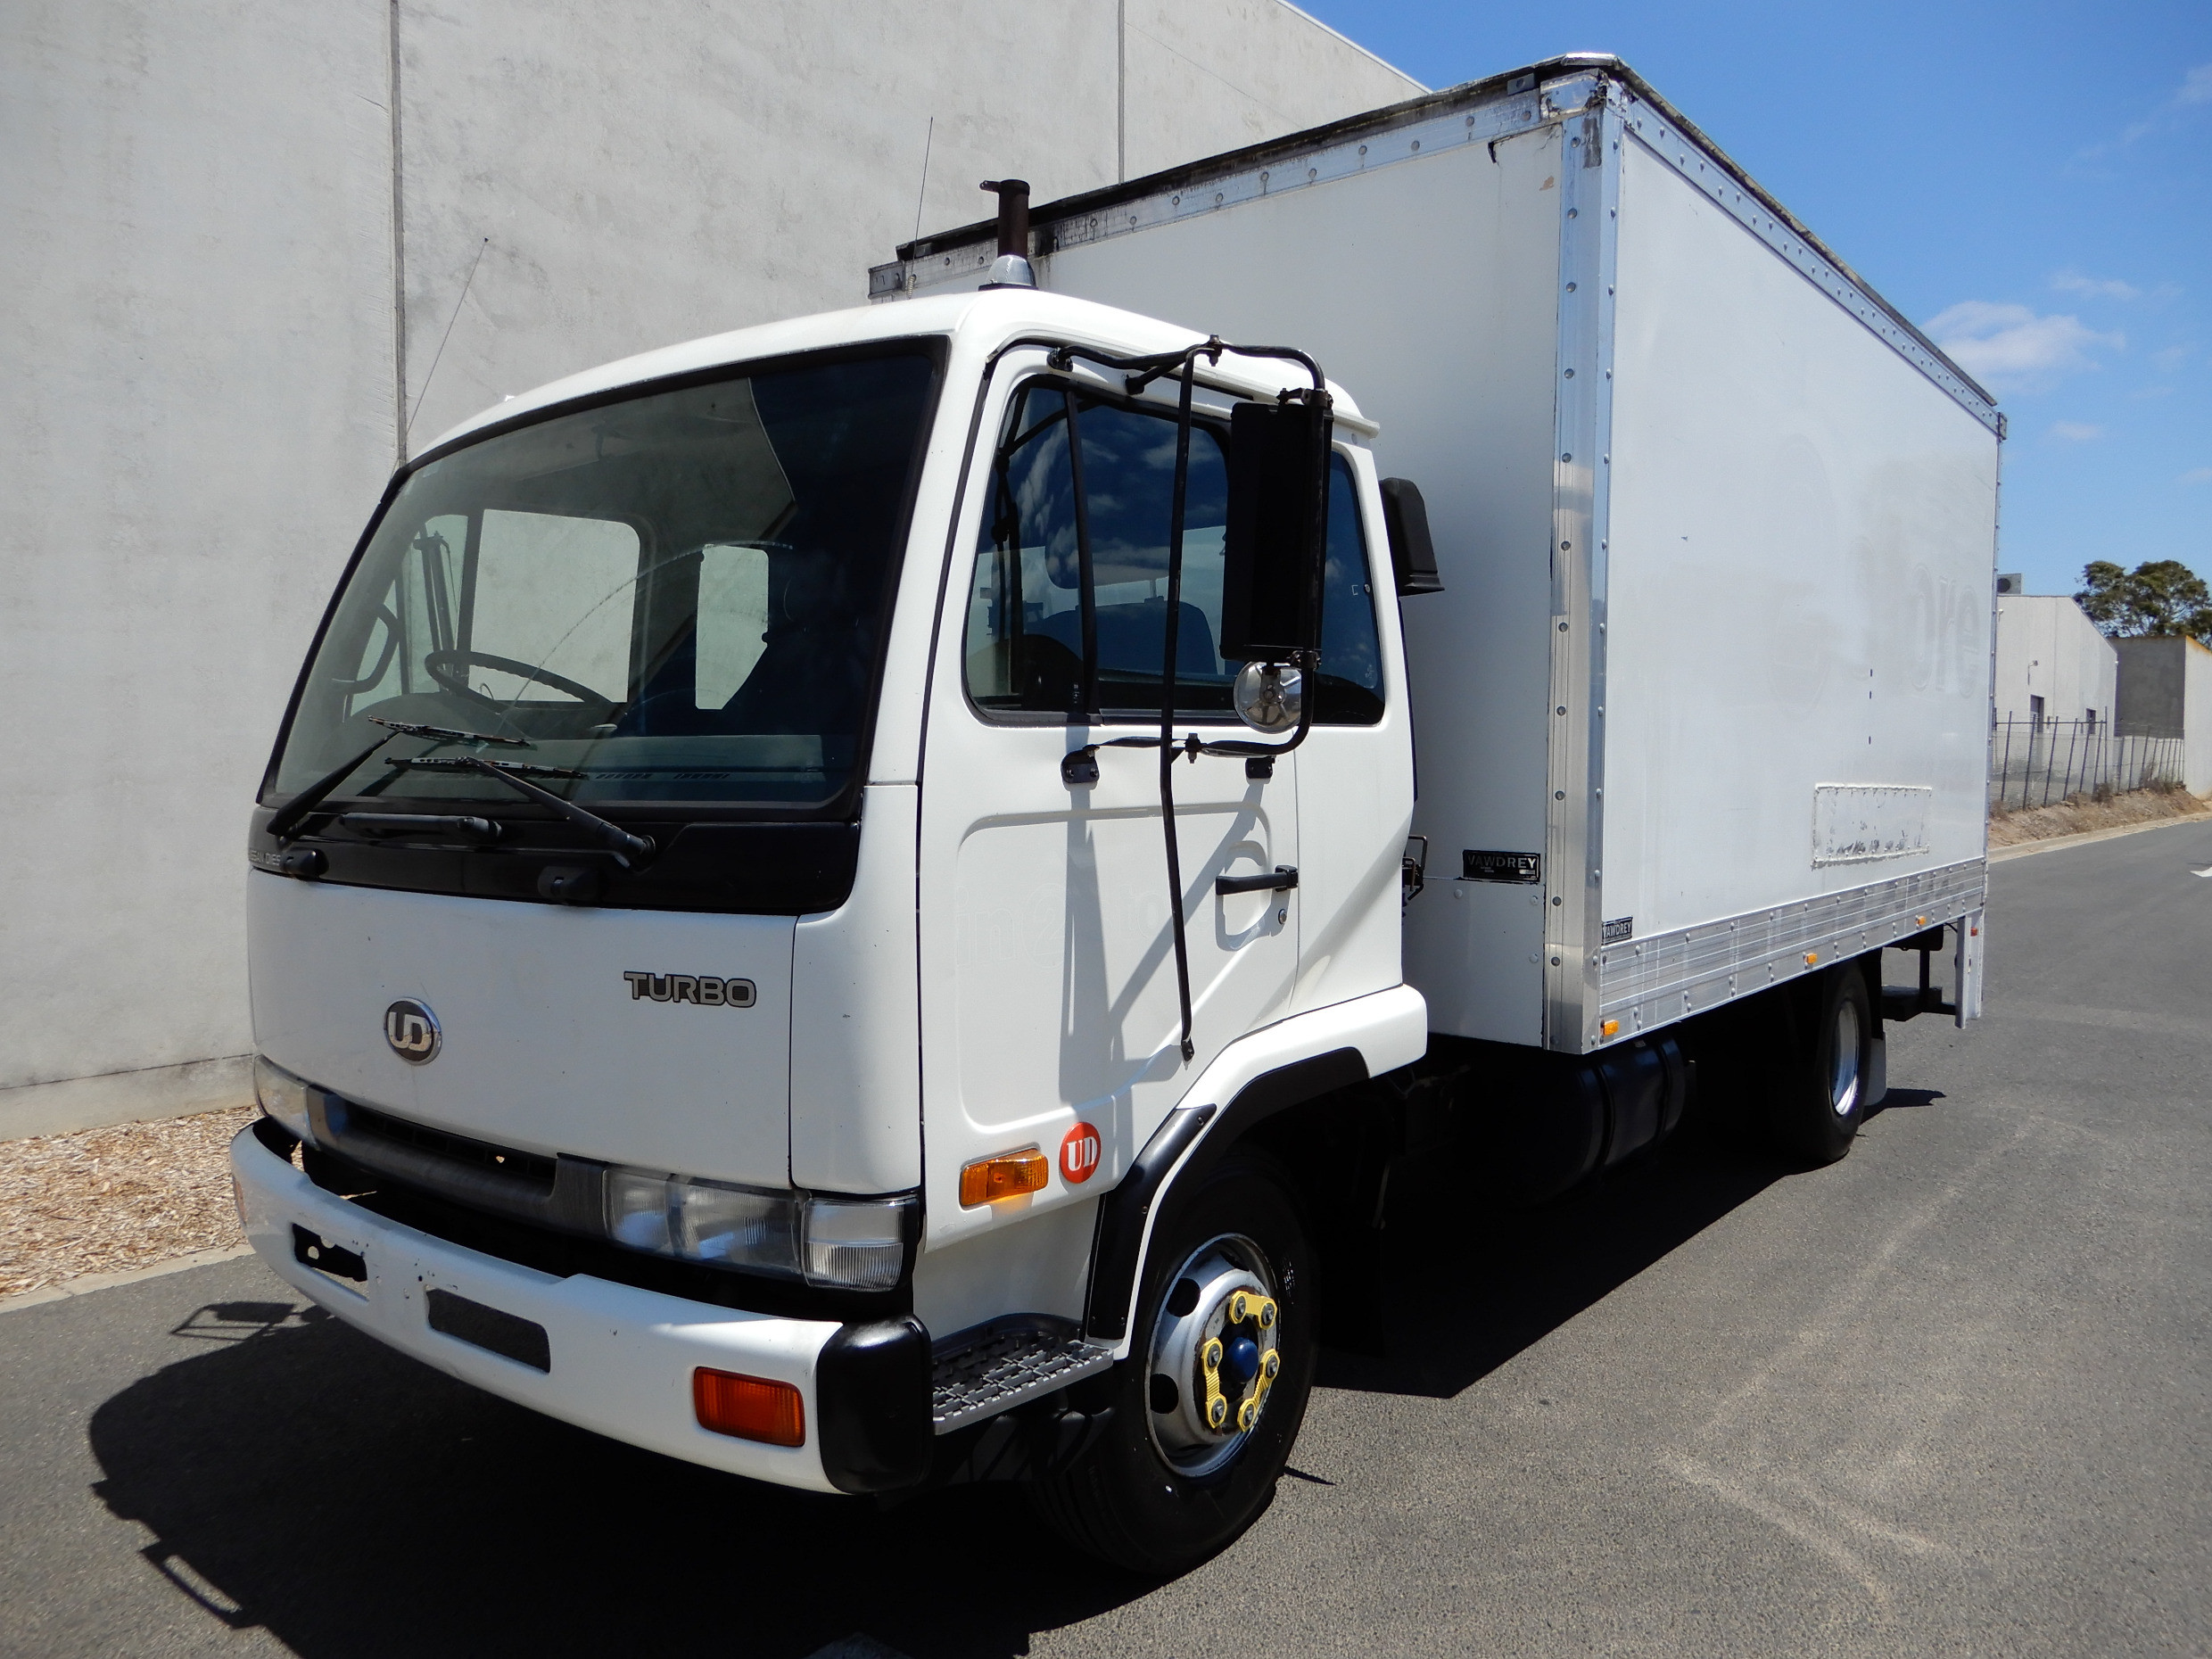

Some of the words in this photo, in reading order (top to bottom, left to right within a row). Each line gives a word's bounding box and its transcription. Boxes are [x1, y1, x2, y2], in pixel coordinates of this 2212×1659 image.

[1467, 854, 1537, 869] VAWDREY
[1602, 921, 1631, 939] VAWDREY
[624, 970, 757, 1009] TURBO
[387, 1011, 433, 1052] UD
[1067, 1136, 1098, 1171] UD
